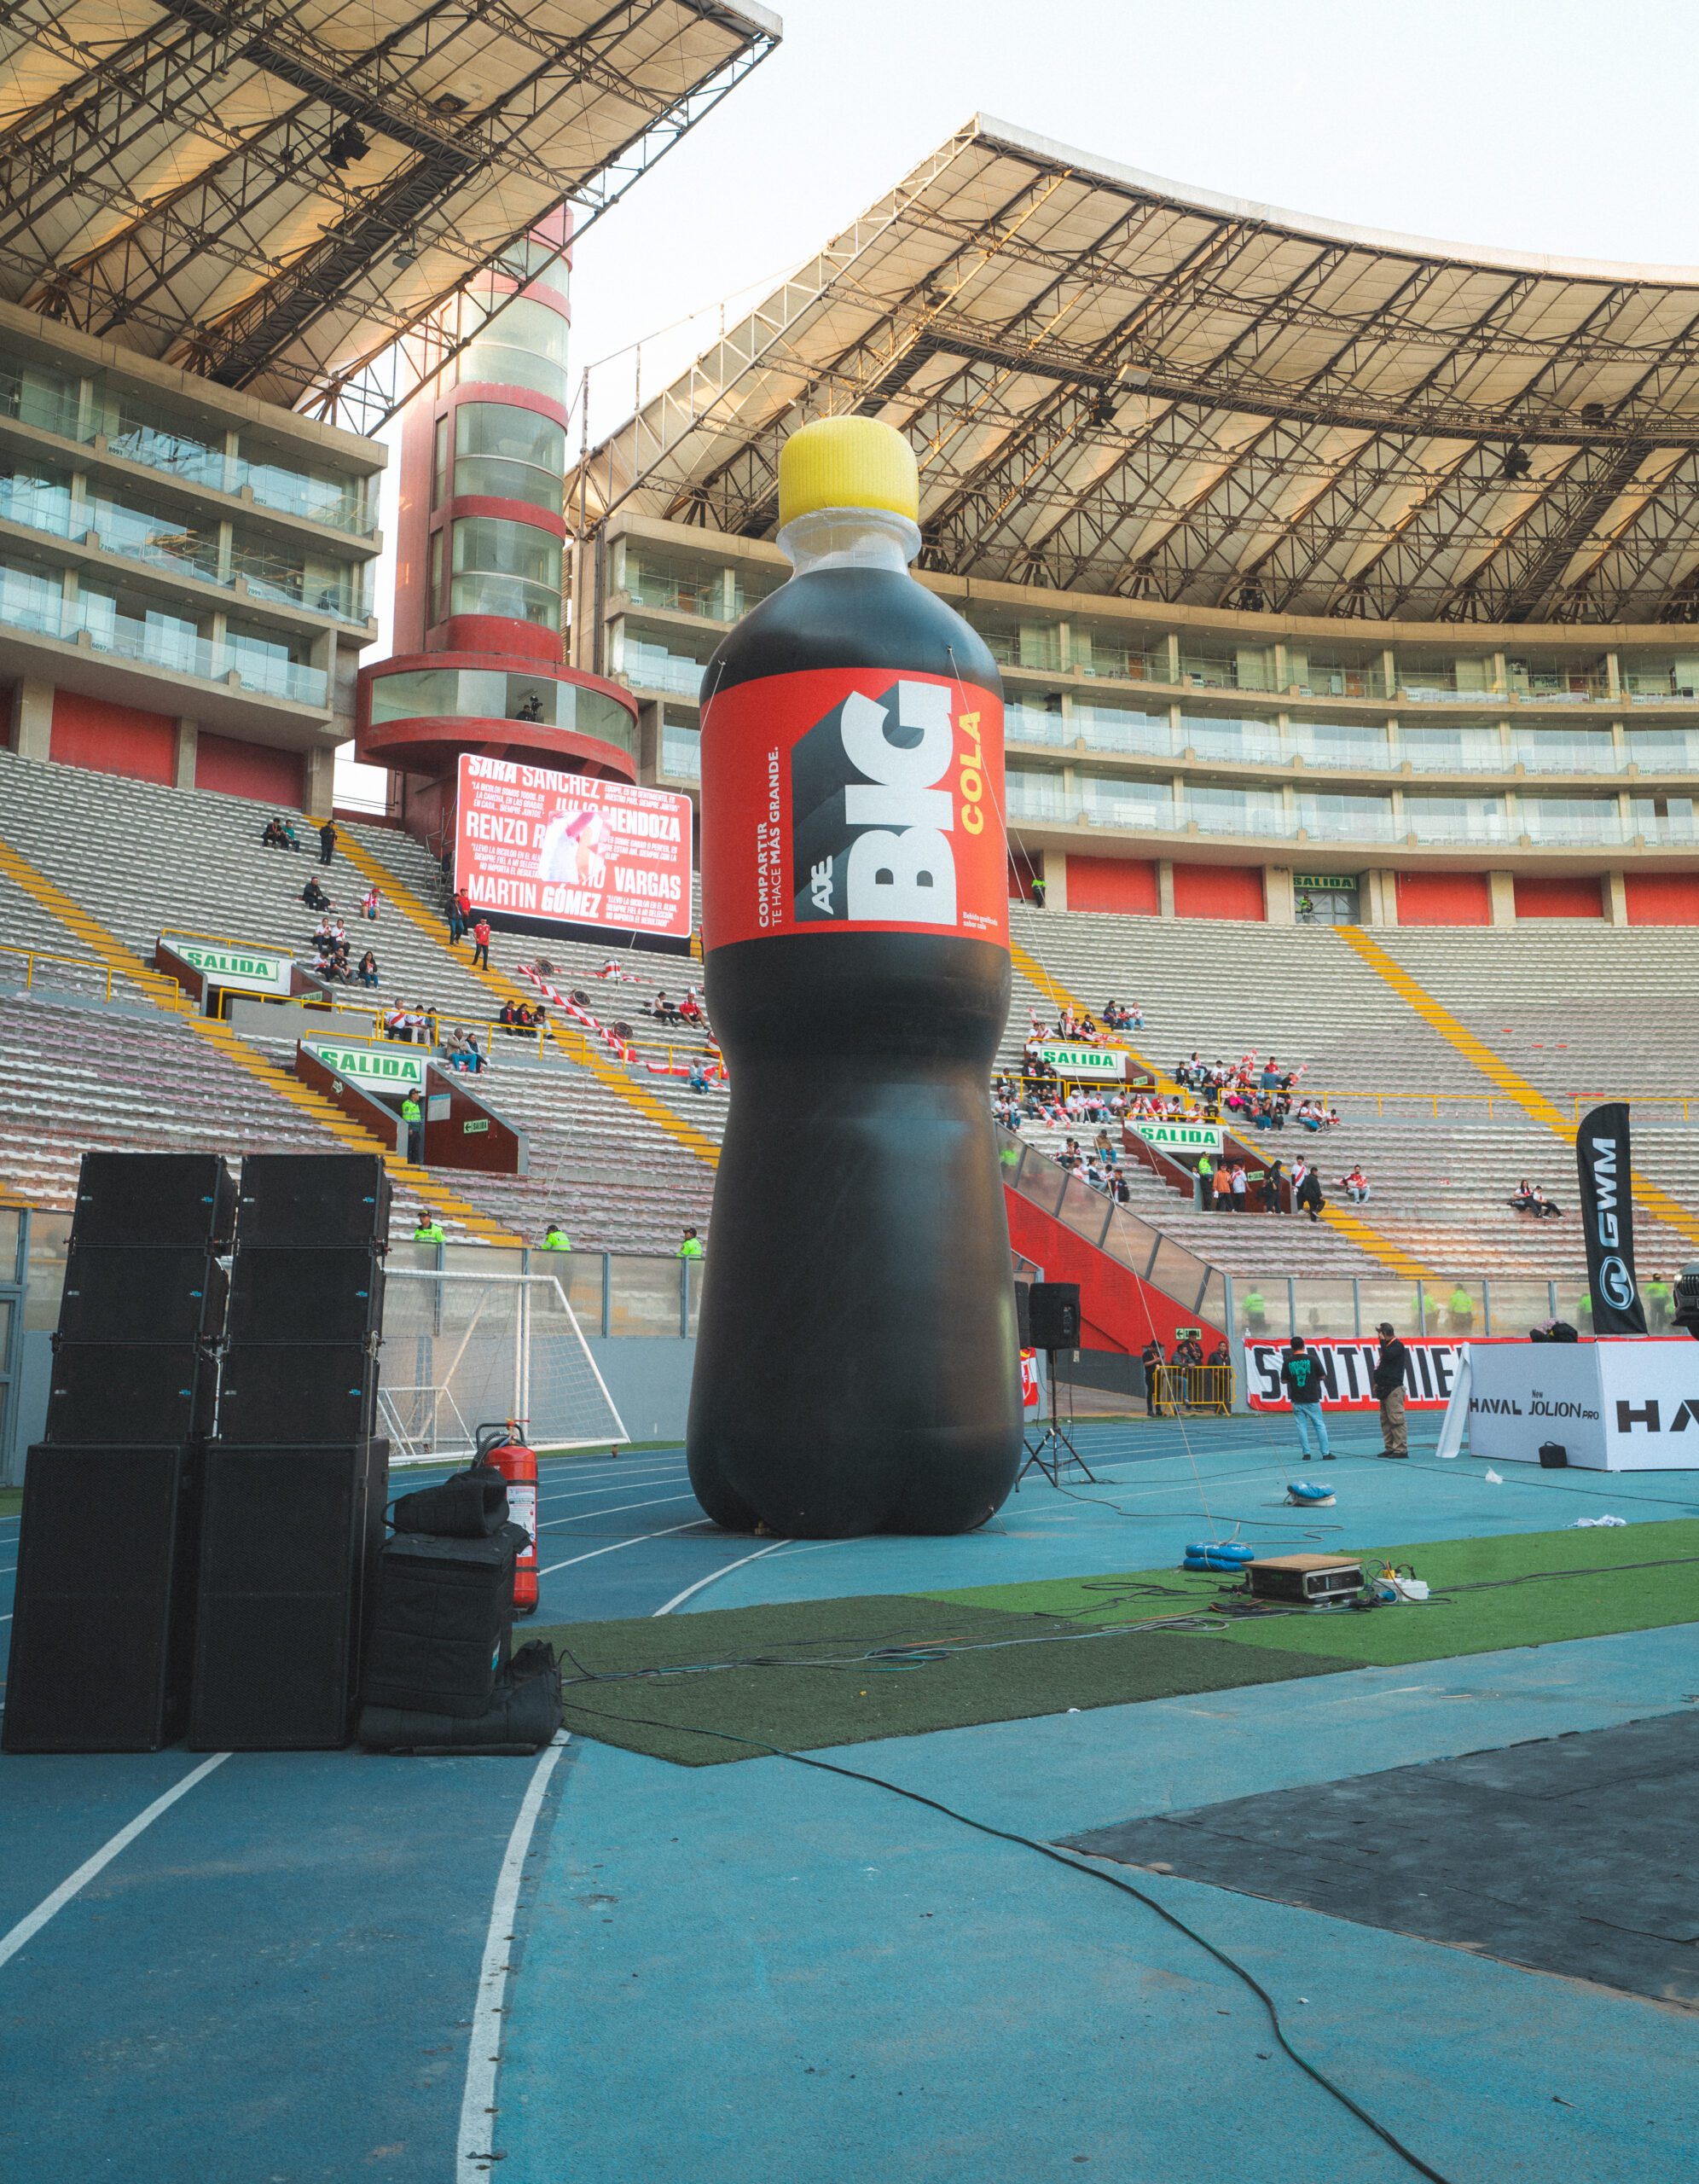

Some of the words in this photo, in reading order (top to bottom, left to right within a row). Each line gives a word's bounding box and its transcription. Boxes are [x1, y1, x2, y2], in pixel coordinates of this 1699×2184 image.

[101, 543, 115, 554] 7100
[91, 642, 107, 651] 6097
[468, 758, 517, 783] SARA
[959, 712, 984, 835] COLA
[480, 782, 502, 793] BICOLOR
[537, 793, 545, 802] EN
[768, 746, 780, 823] GRANDE.
[473, 799, 481, 807] EN
[499, 804, 521, 815] SIEMPRE
[476, 791, 483, 799] LA
[505, 796, 513, 804] EN
[513, 798, 523, 807] LAS
[840, 680, 957, 926] BIG
[467, 811, 528, 846] RENZO
[489, 845, 496, 854] LA
[517, 851, 525, 859] EN
[525, 851, 531, 861] EL
[768, 828, 782, 864] MÁS
[473, 851, 496, 863] SIEMPRE
[496, 856, 507, 865] FIEL
[512, 858, 519, 867] MI
[479, 862, 487, 870] NO
[487, 863, 510, 874] IMPORTA
[510, 866, 516, 875] EL
[614, 866, 681, 900] VARGAS
[757, 822, 768, 927] COMPARTIR
[1294, 877, 1353, 888] SALIDA
[468, 874, 536, 909] MARTIN
[541, 883, 602, 919] GÓMEZ
[772, 868, 782, 909] HACE
[606, 903, 627, 914] SIEMPRE
[637, 907, 641, 915] A
[623, 897, 629, 905] LA
[657, 902, 663, 910] EL
[772, 909, 782, 926] TE
[187, 951, 269, 976] SALIDA
[321, 1050, 419, 1079] SALIDA
[1043, 1050, 1115, 1067] SALIDA
[473, 1121, 487, 1131] SALIDA
[1140, 1127, 1217, 1145] SALIDA
[1592, 1137, 1619, 1248] GWM
[1532, 1389, 1544, 1399] New
[1470, 1397, 1522, 1416] HAVAL
[1528, 1401, 1581, 1418] JOLION
[1582, 1410, 1599, 1420] PRO
